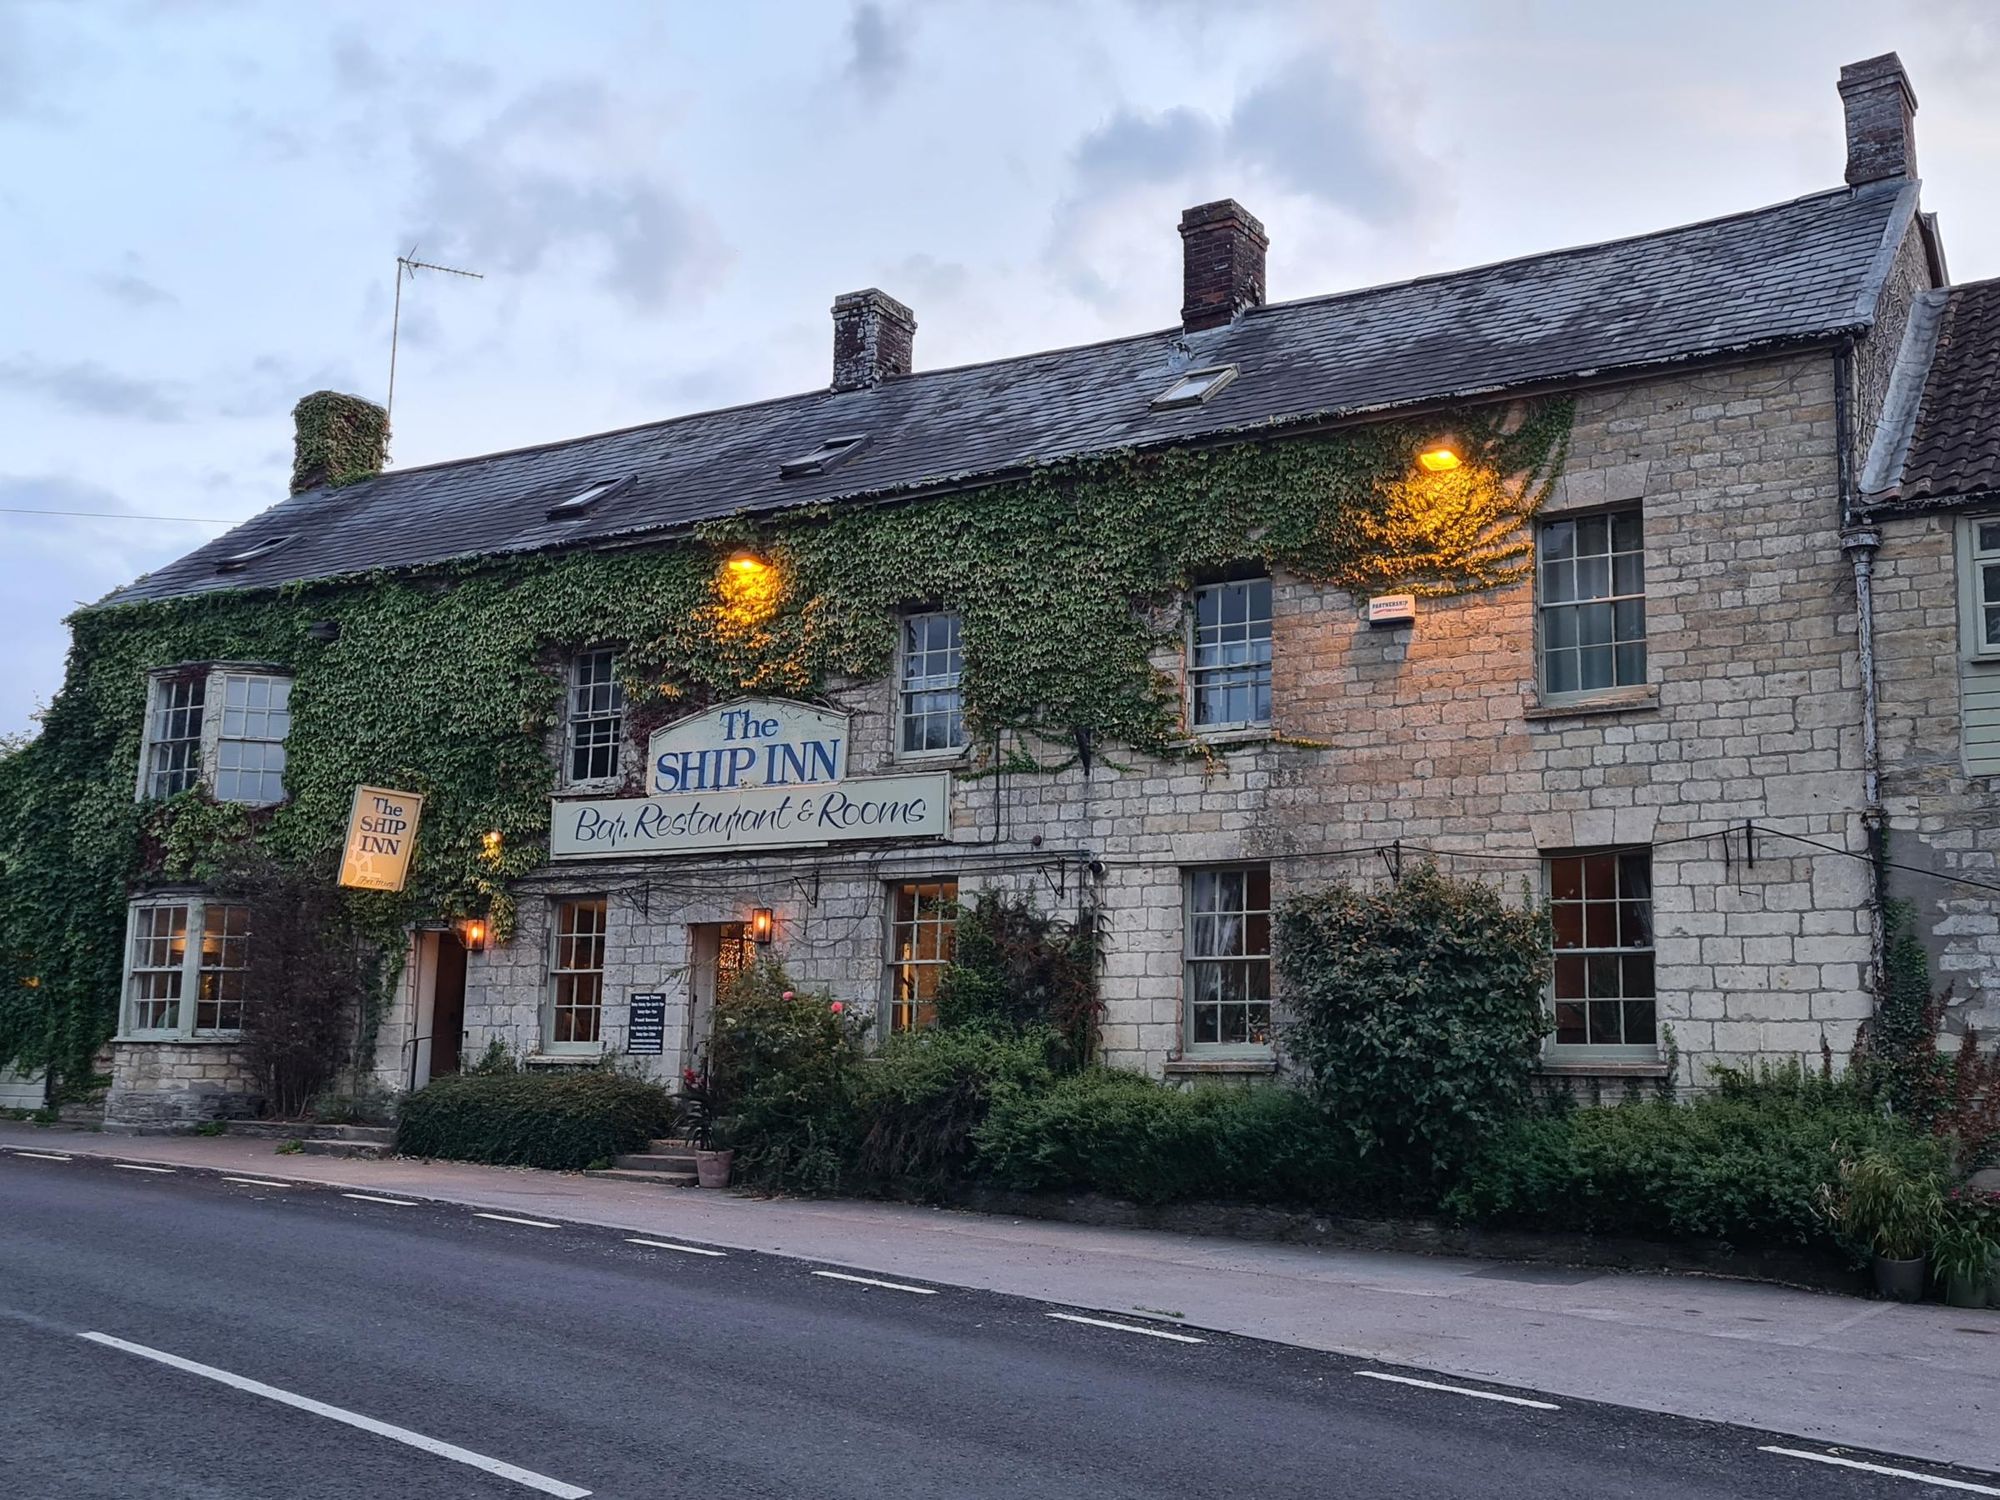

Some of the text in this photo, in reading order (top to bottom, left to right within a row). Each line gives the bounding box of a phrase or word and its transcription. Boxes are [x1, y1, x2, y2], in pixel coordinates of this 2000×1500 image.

[720, 709, 778, 741] The
[655, 739, 841, 792] SHIP INN
[373, 797, 403, 816] The
[633, 796, 792, 841] Restaurant
[797, 799, 814, 822] &
[817, 791, 926, 829] Rooms
[360, 816, 407, 835] SHIP
[360, 835, 401, 855] INN
